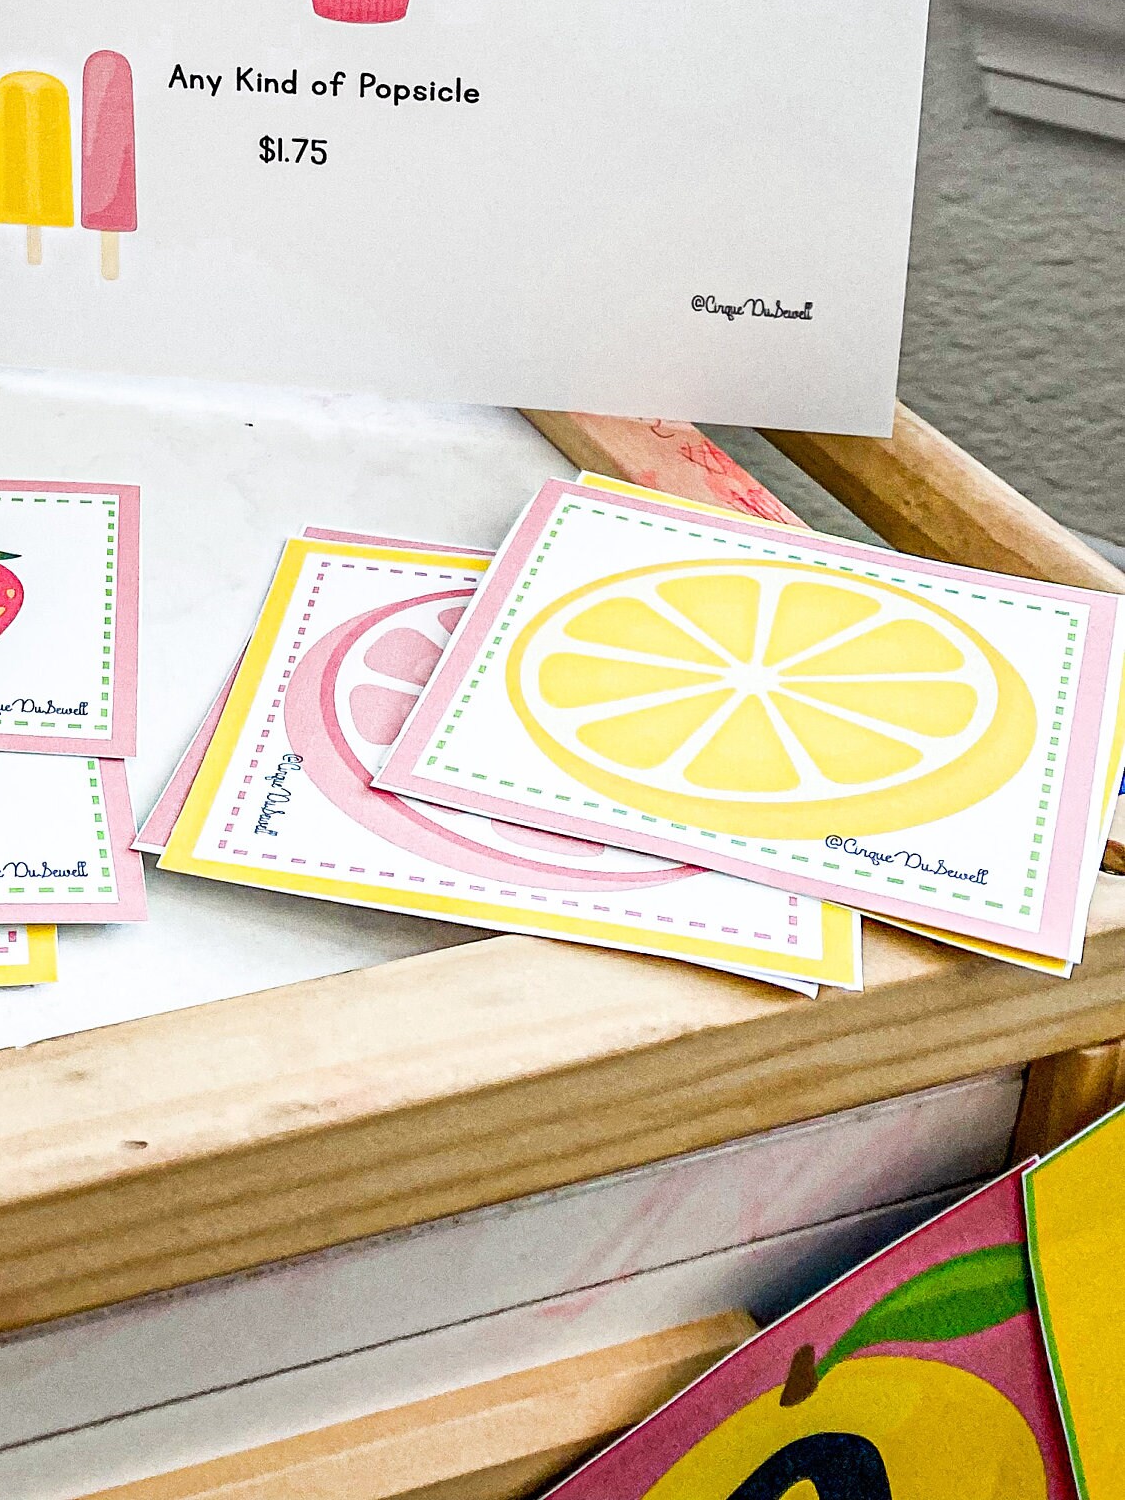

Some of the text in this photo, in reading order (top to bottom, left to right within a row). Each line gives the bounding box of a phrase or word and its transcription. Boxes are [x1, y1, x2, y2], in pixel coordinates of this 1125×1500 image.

[168, 63, 480, 107] Any Kind of Popsicle
[258, 134, 328, 166] $1.75
